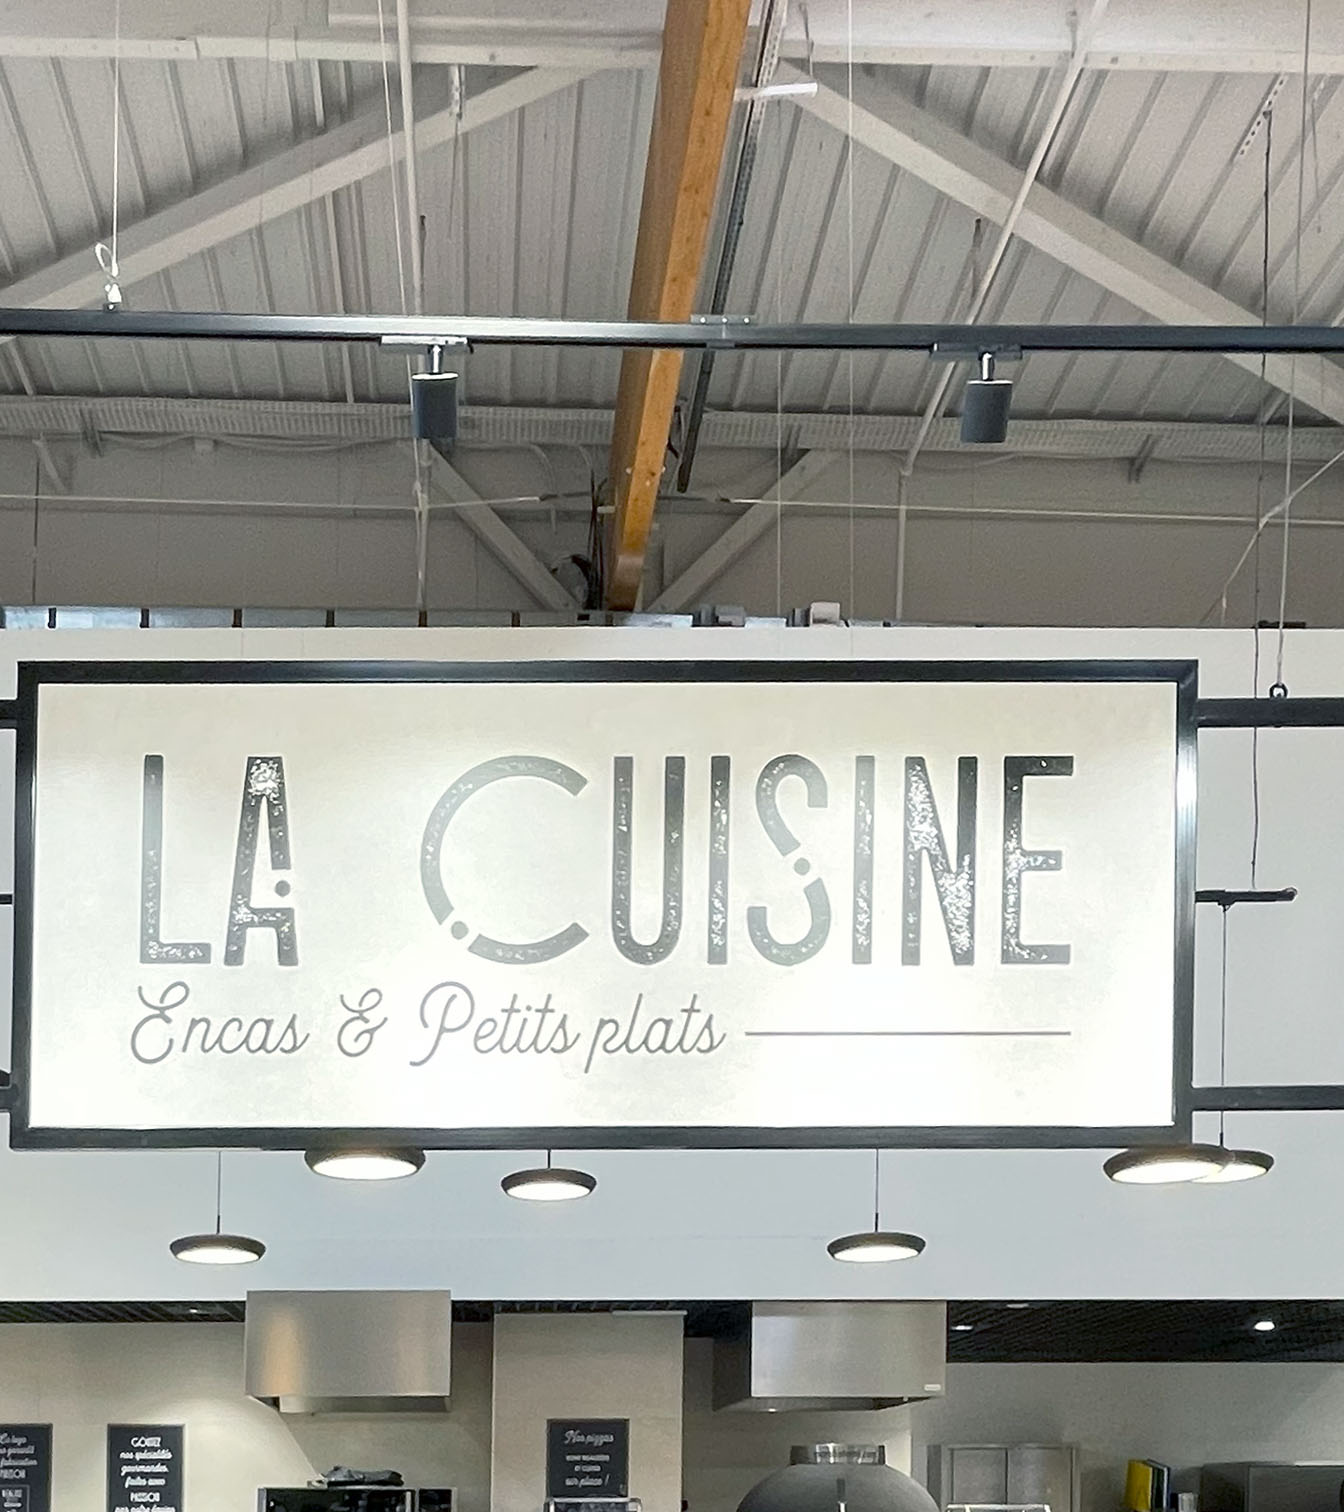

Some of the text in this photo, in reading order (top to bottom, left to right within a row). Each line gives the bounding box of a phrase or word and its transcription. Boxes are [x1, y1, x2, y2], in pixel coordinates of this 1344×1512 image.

[140, 754, 1074, 966] LA CUISINE
[130, 980, 726, 1074] Encas & Petits plats
